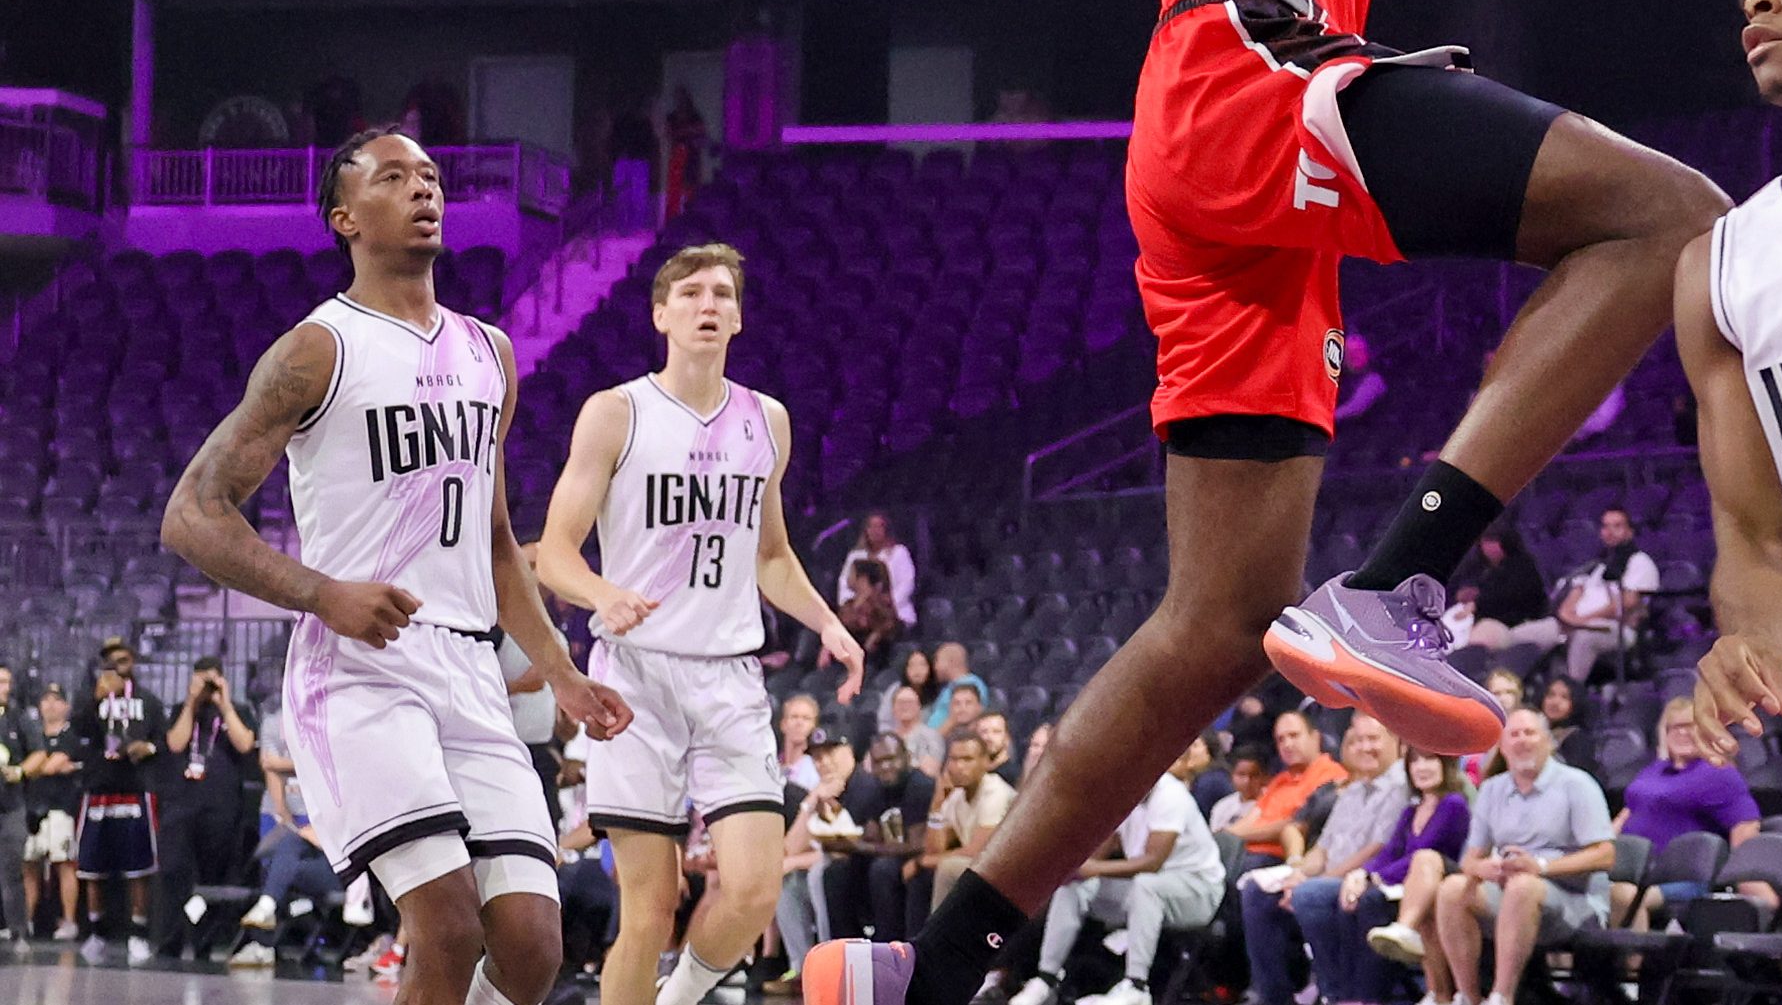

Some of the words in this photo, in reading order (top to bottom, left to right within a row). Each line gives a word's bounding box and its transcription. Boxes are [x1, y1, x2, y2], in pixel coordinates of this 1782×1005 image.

[415, 373, 464, 388] NBAGL
[439, 475, 465, 548] 0
[688, 532, 726, 590] 13
